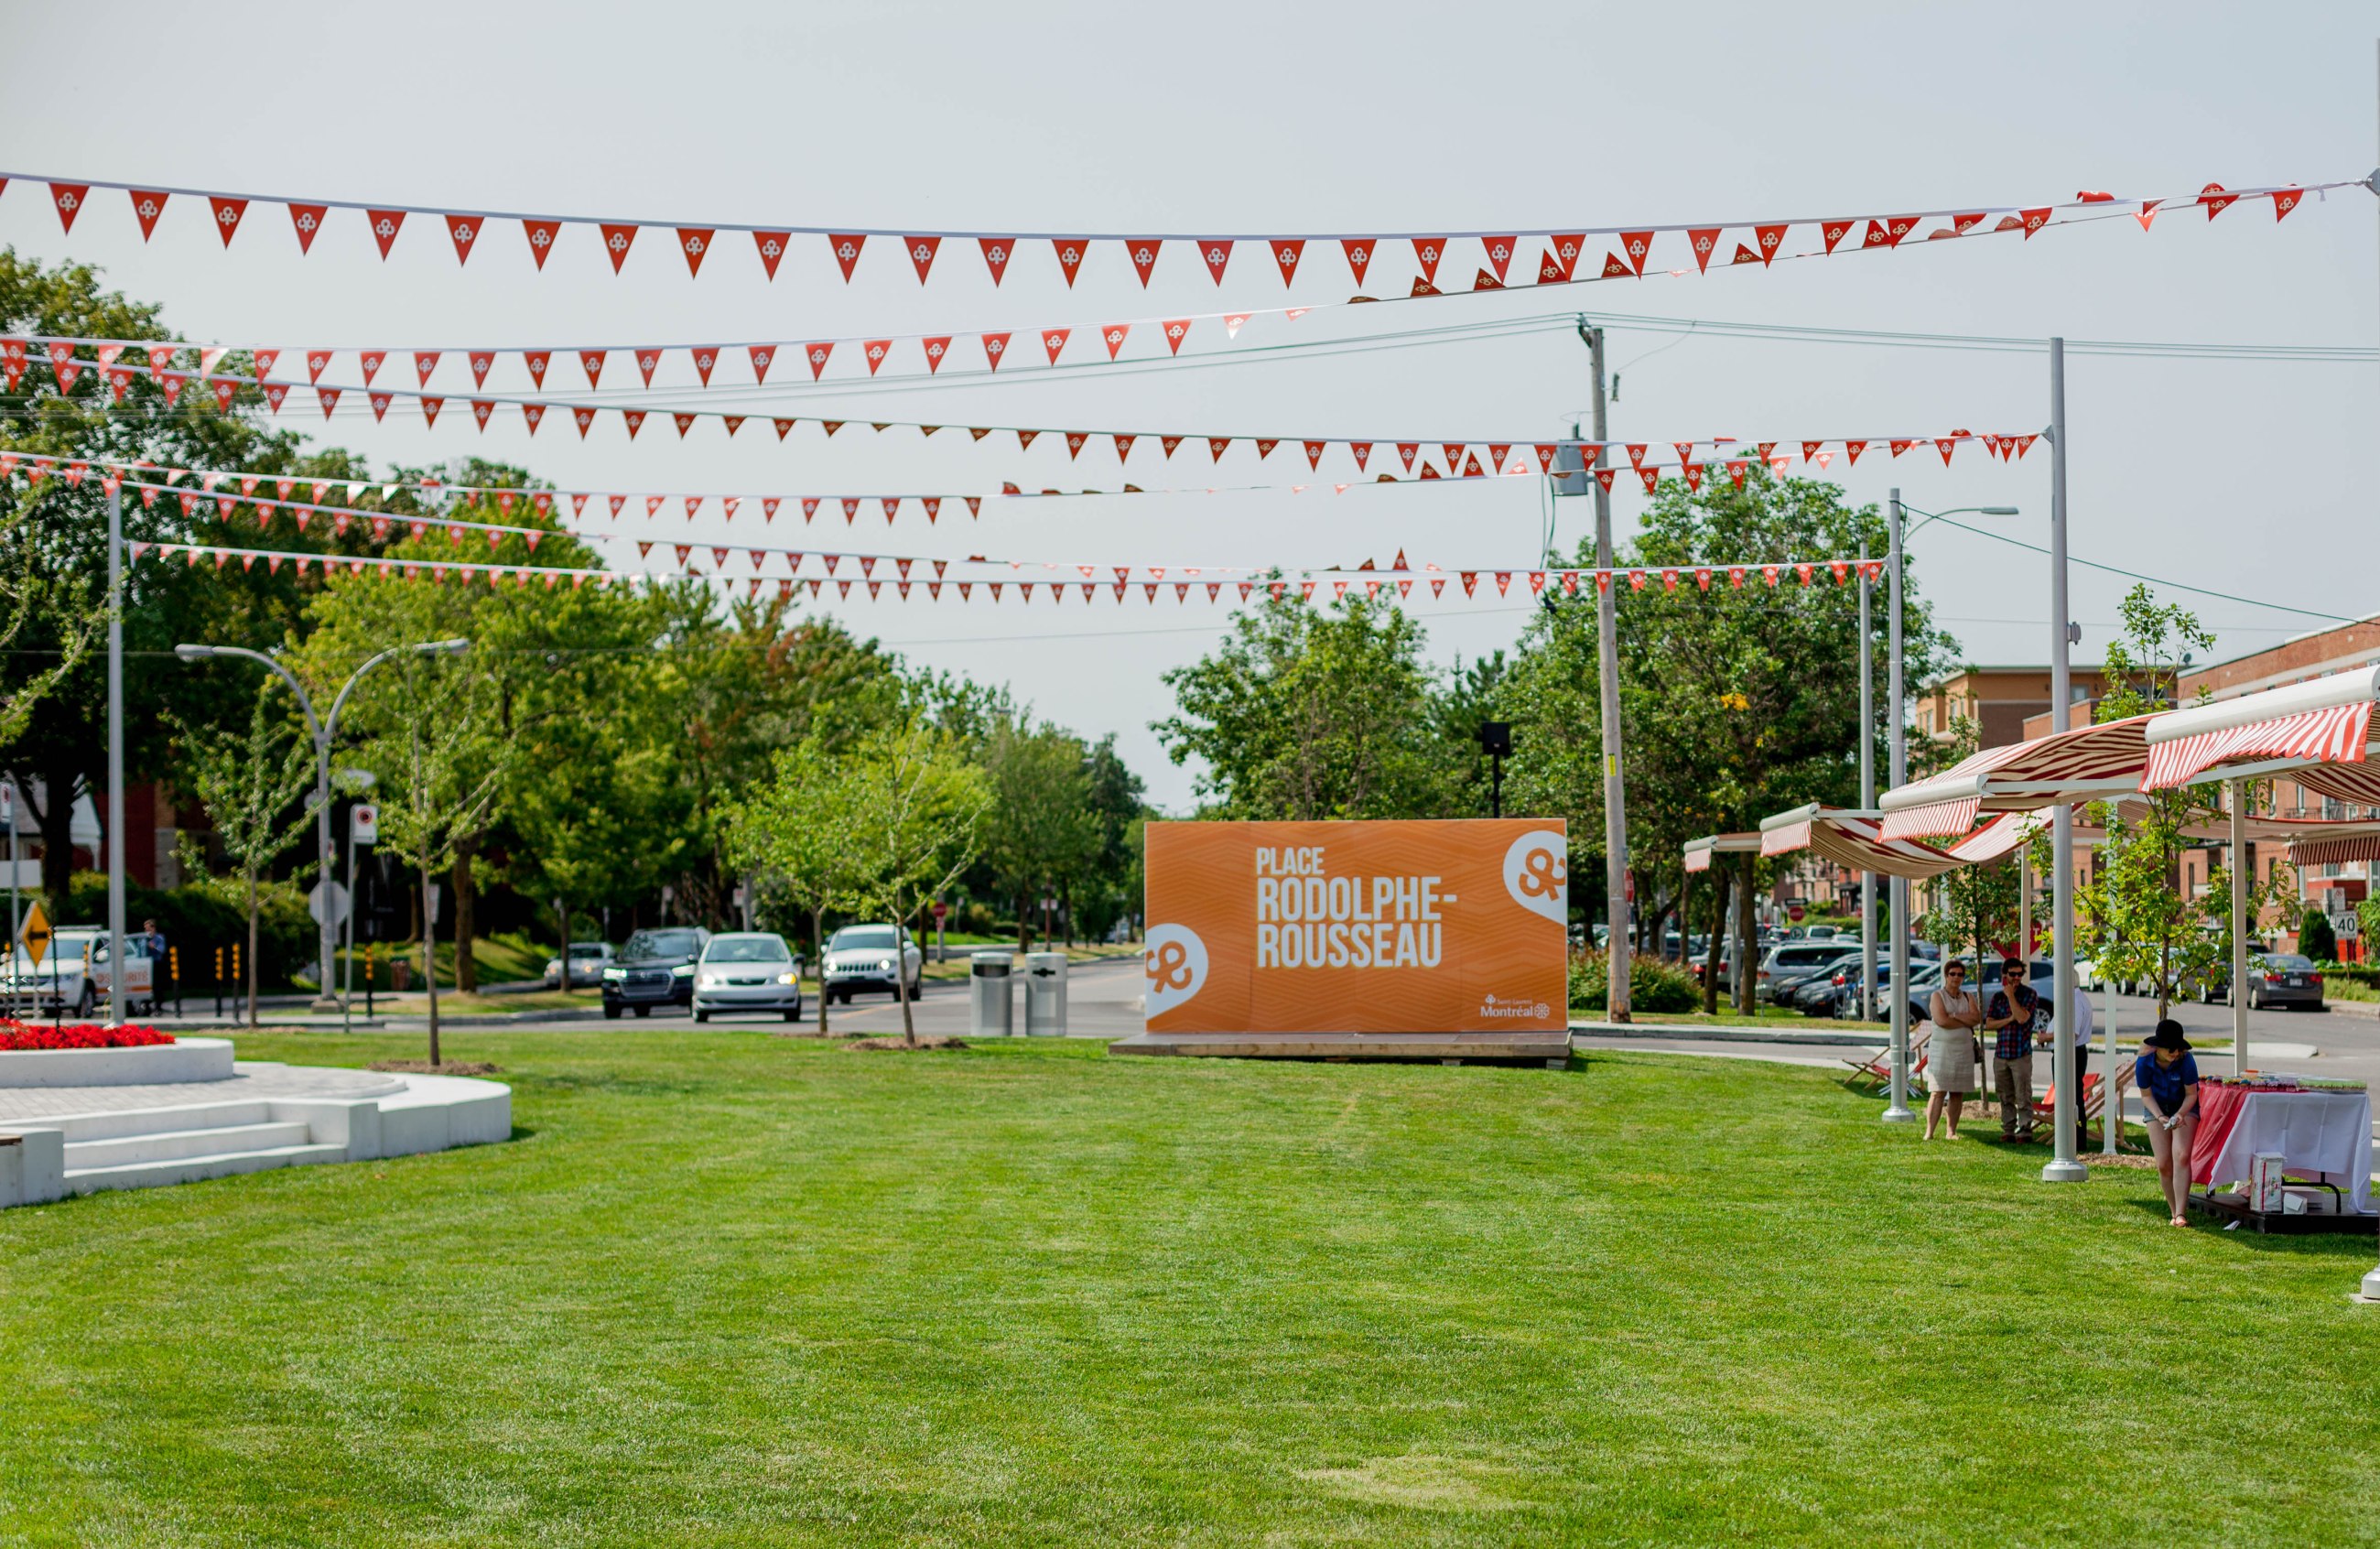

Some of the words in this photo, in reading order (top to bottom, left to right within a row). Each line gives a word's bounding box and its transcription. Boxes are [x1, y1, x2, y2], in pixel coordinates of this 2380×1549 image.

[1256, 847, 1325, 875] PLACE
[1258, 876, 1457, 921] RODOLPHE-
[2338, 917, 2355, 931] 40
[1258, 923, 1442, 968] ROUSSEAU
[1480, 1005, 1533, 1017] Montréal
